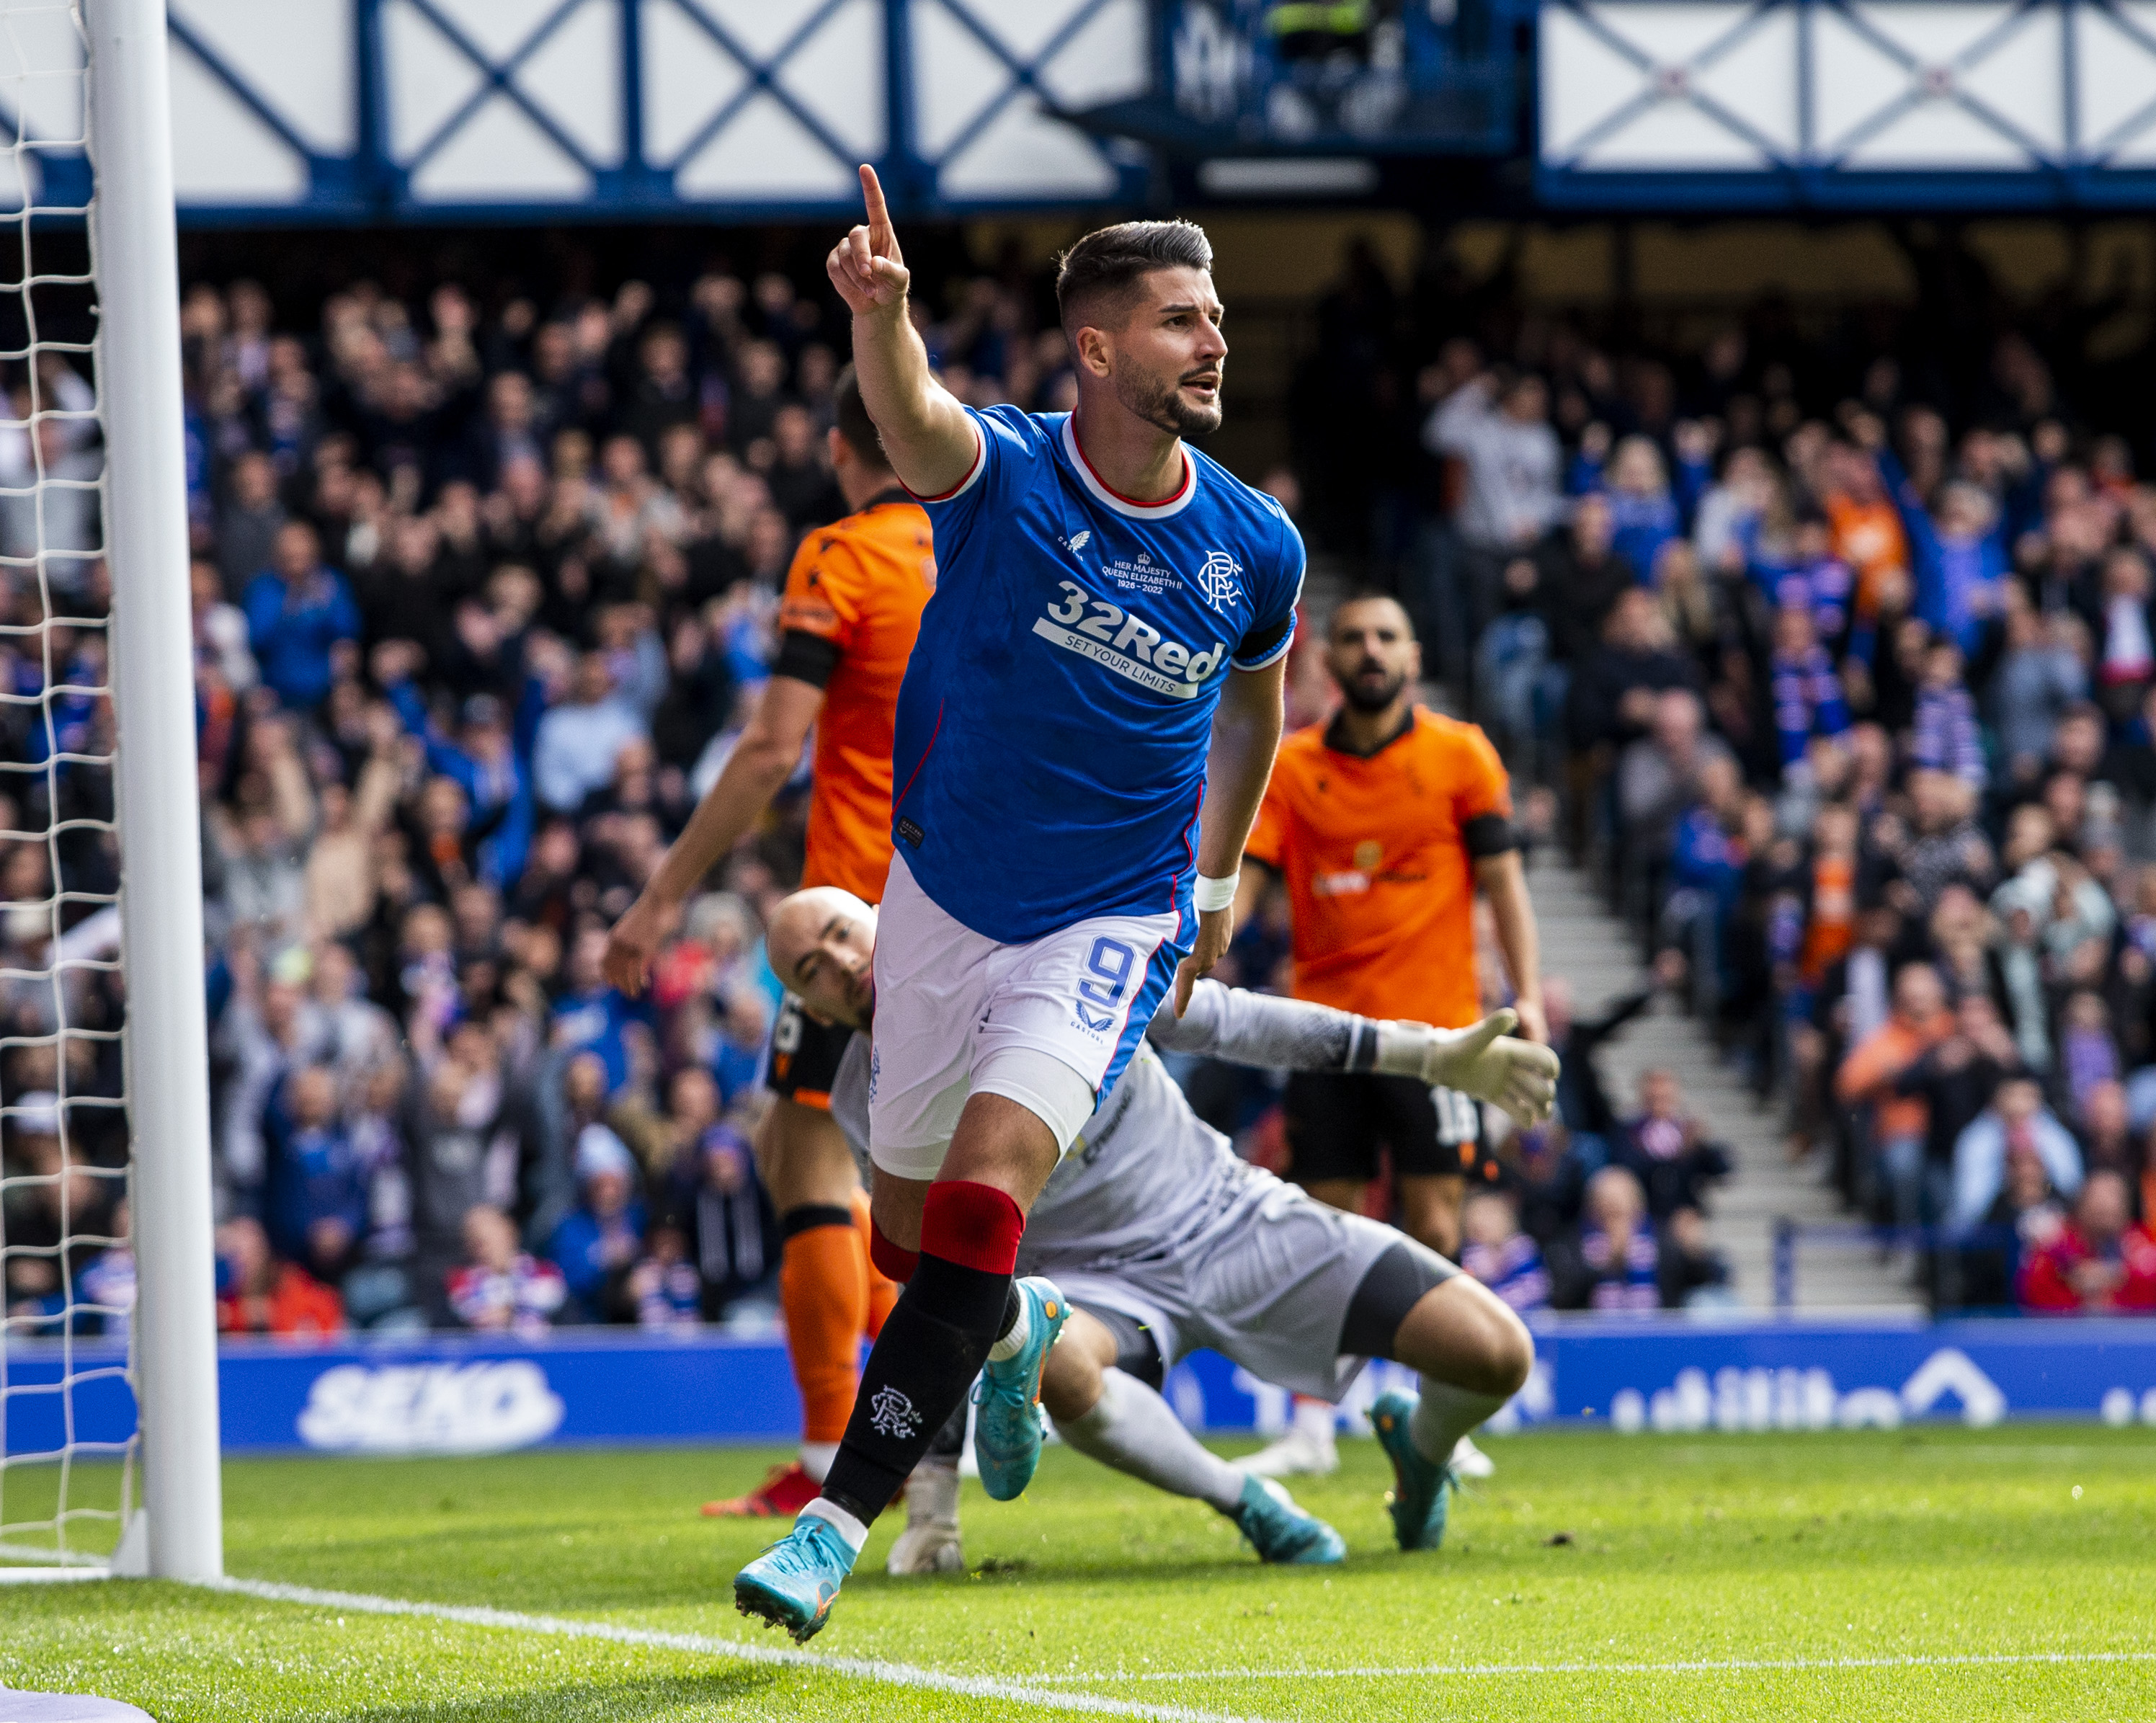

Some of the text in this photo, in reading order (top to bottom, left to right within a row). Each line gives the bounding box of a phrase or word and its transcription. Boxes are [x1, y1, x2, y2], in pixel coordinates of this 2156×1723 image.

[1102, 566, 1182, 589] QUEEN ELIZABETH II
[1114, 560, 1172, 579] HER MAJESTY
[1117, 579, 1136, 589] 1926
[1141, 584, 1163, 595] 2022
[1048, 580, 1226, 682] 32Red
[1065, 636, 1176, 693] SET YOUR LIMITS
[1077, 934, 1137, 1010] 9
